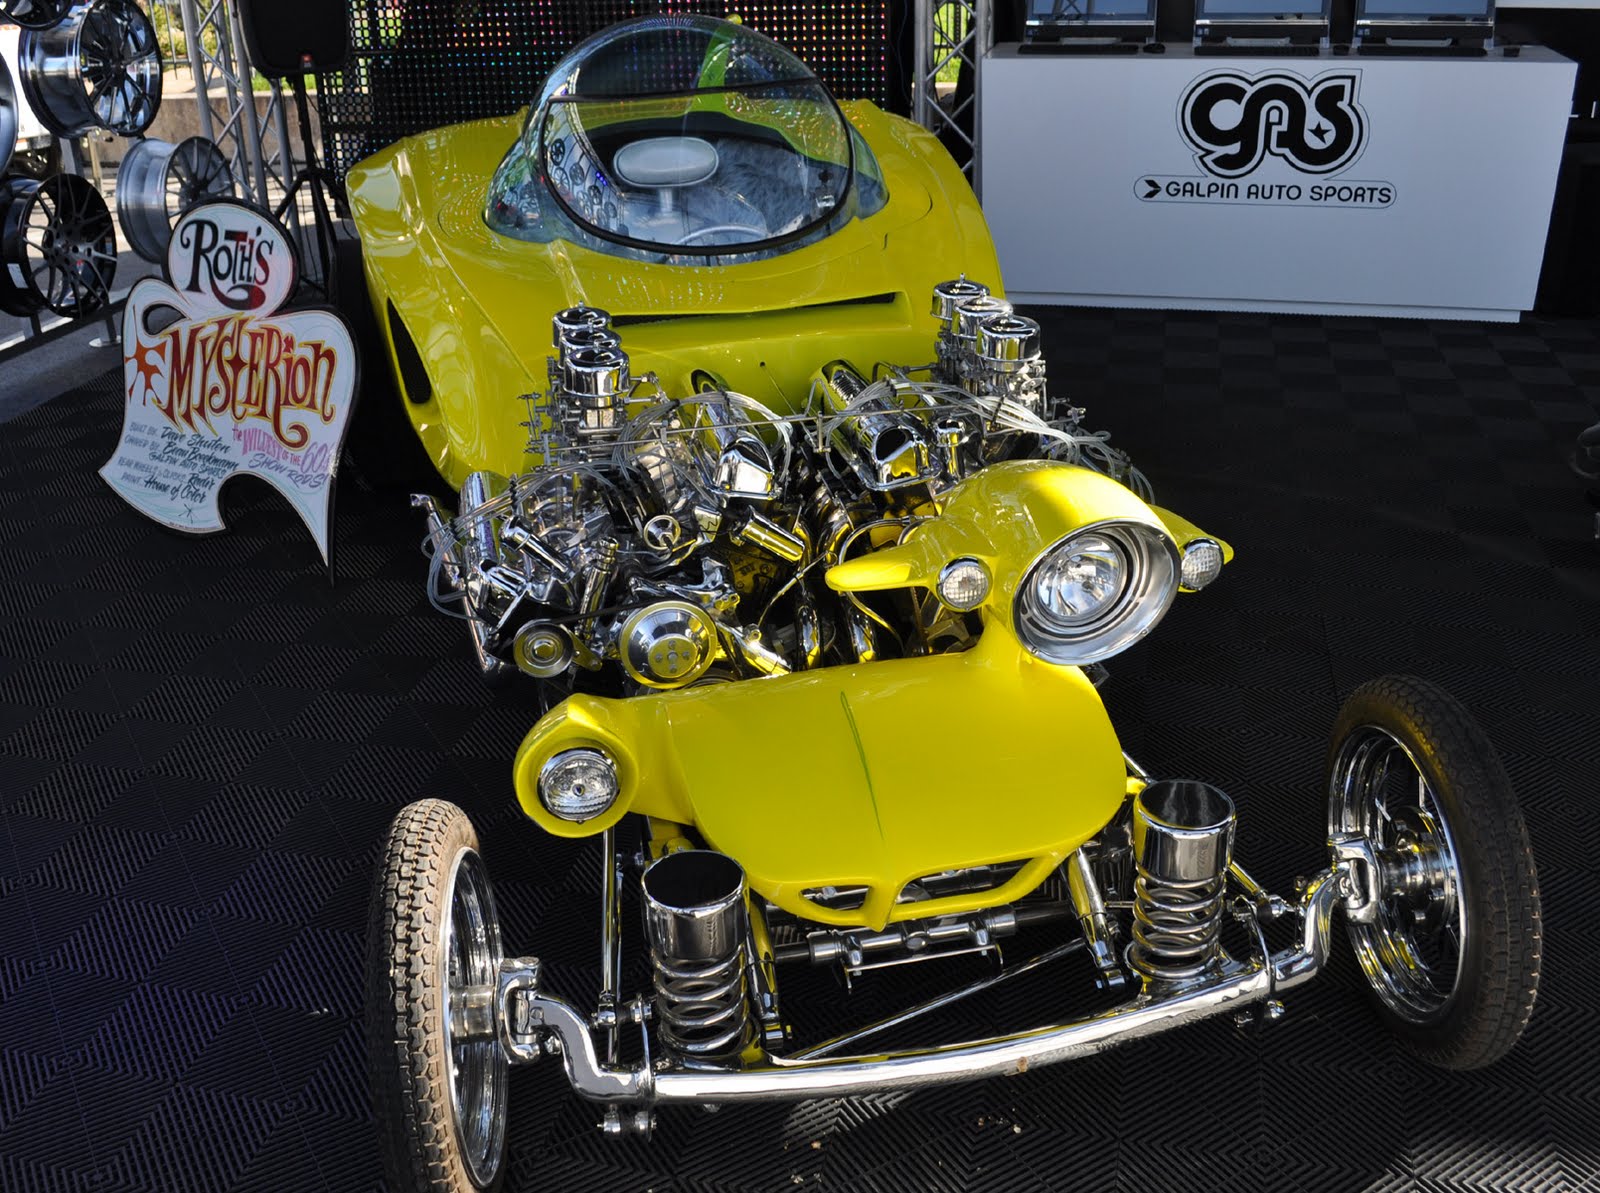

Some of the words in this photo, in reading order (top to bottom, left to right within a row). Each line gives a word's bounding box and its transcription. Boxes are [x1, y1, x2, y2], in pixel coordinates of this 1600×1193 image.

[1165, 181, 1239, 199] GALPIN
[1246, 183, 1302, 201] AUTO
[1309, 185, 1392, 204] SPORTS
[248, 453, 288, 474] SHOW
[144, 474, 171, 493] House
[170, 484, 182, 501] of
[181, 484, 207, 504] Color
